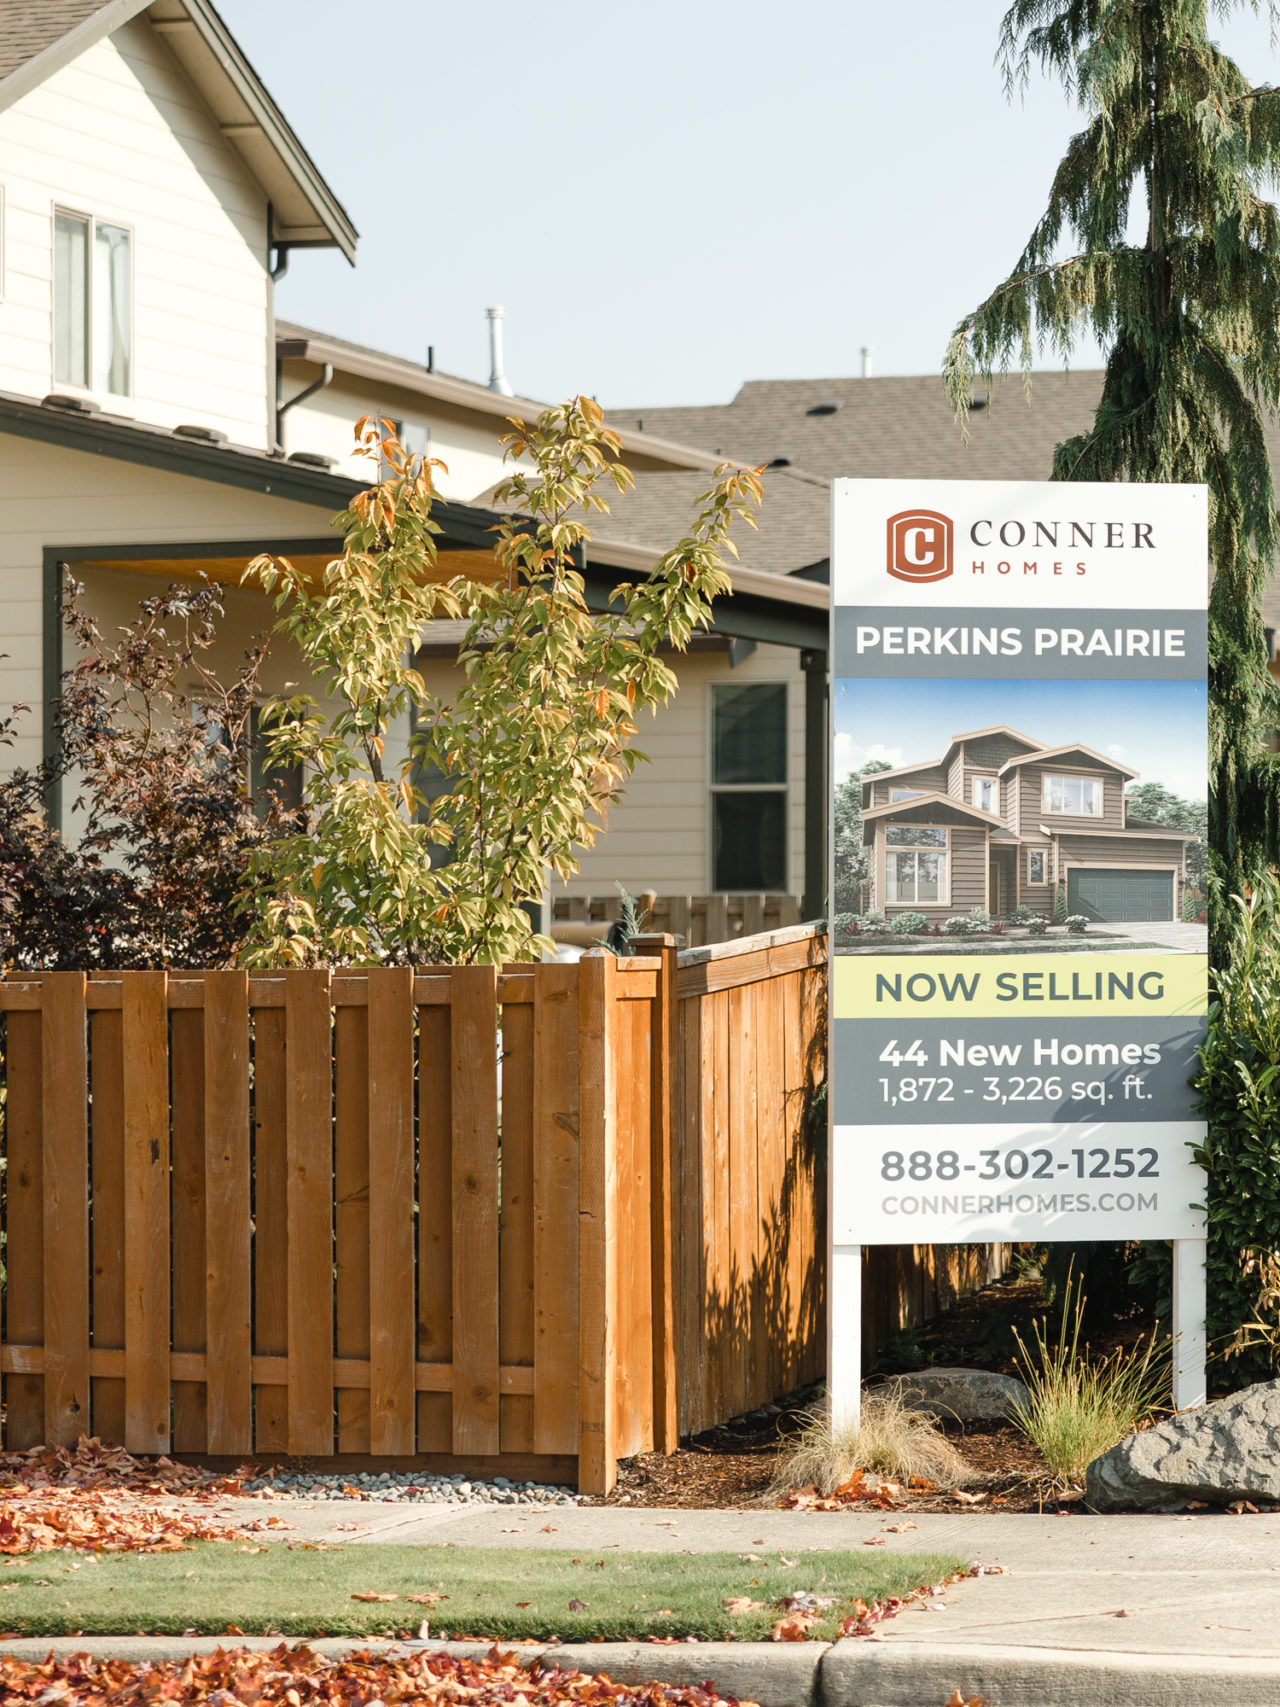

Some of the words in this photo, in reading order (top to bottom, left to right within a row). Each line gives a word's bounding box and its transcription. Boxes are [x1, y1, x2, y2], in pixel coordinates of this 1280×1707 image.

[970, 519, 1157, 549] CONNER
[972, 561, 1086, 575] HOMES
[856, 626, 1023, 656] PERKINS
[1035, 628, 1185, 657] PRAIRIE
[876, 972, 981, 1002] NOW
[995, 971, 1164, 1001] SELLING
[879, 1039, 928, 1067] 44
[940, 1039, 1022, 1067] New
[1034, 1038, 1161, 1066] Homes
[879, 1077, 954, 1106] 1,872
[983, 1076, 1062, 1105] 3,226
[1071, 1079, 1113, 1105] sq.
[1122, 1075, 1152, 1099] ft.
[880, 1148, 1159, 1182] 888-302-1252
[881, 1192, 1158, 1215] CONNERHOMES.COM
